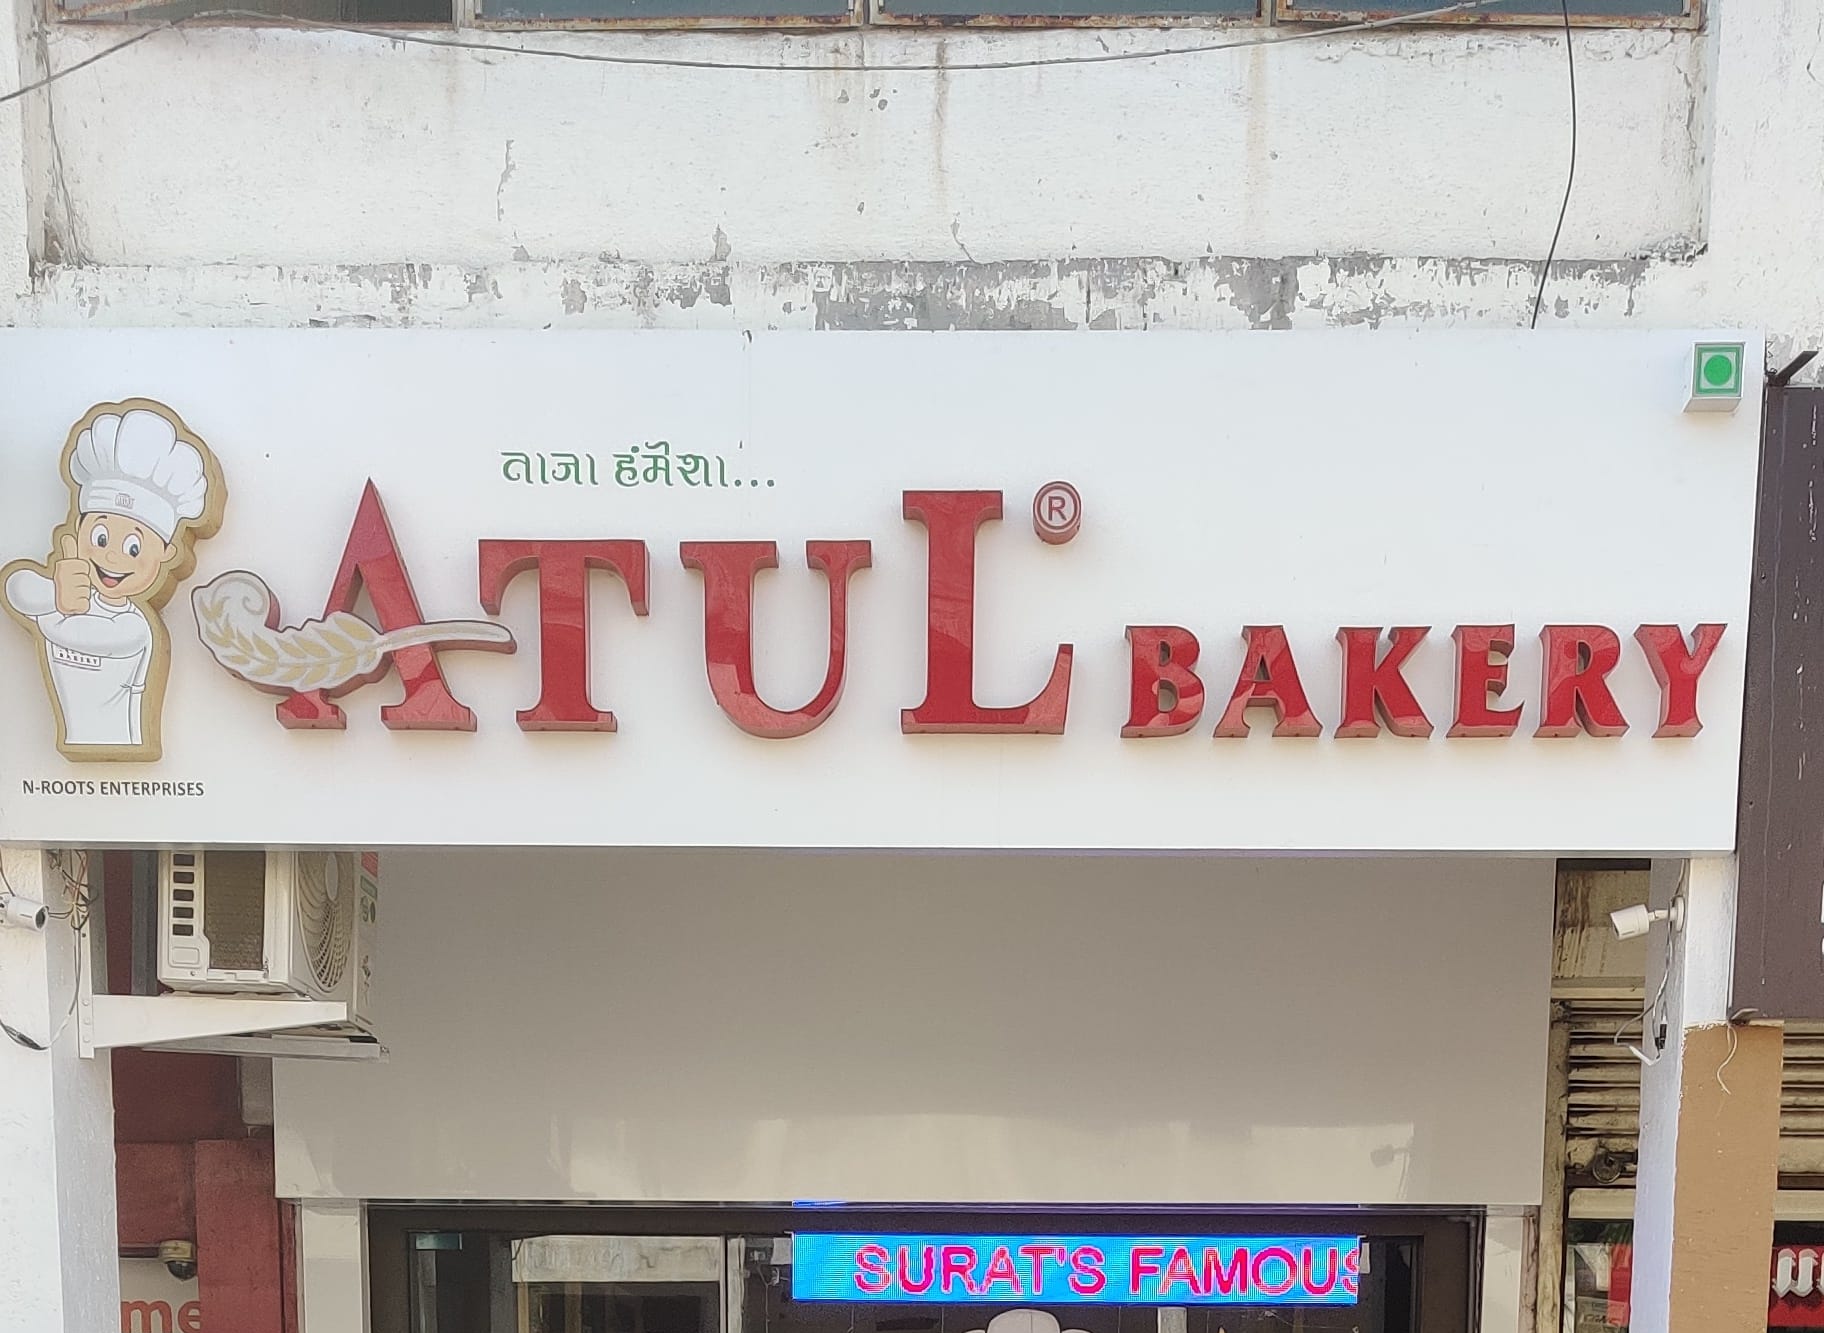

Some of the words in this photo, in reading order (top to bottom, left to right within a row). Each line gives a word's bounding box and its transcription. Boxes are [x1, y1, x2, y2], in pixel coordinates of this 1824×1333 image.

[275, 476, 1075, 740] ATUL
[1119, 623, 1729, 740] BAKERY
[22, 779, 96, 795] N-ROOTS
[100, 780, 205, 797] ENTERPRISES
[854, 1244, 1107, 1295] SURAT'S
